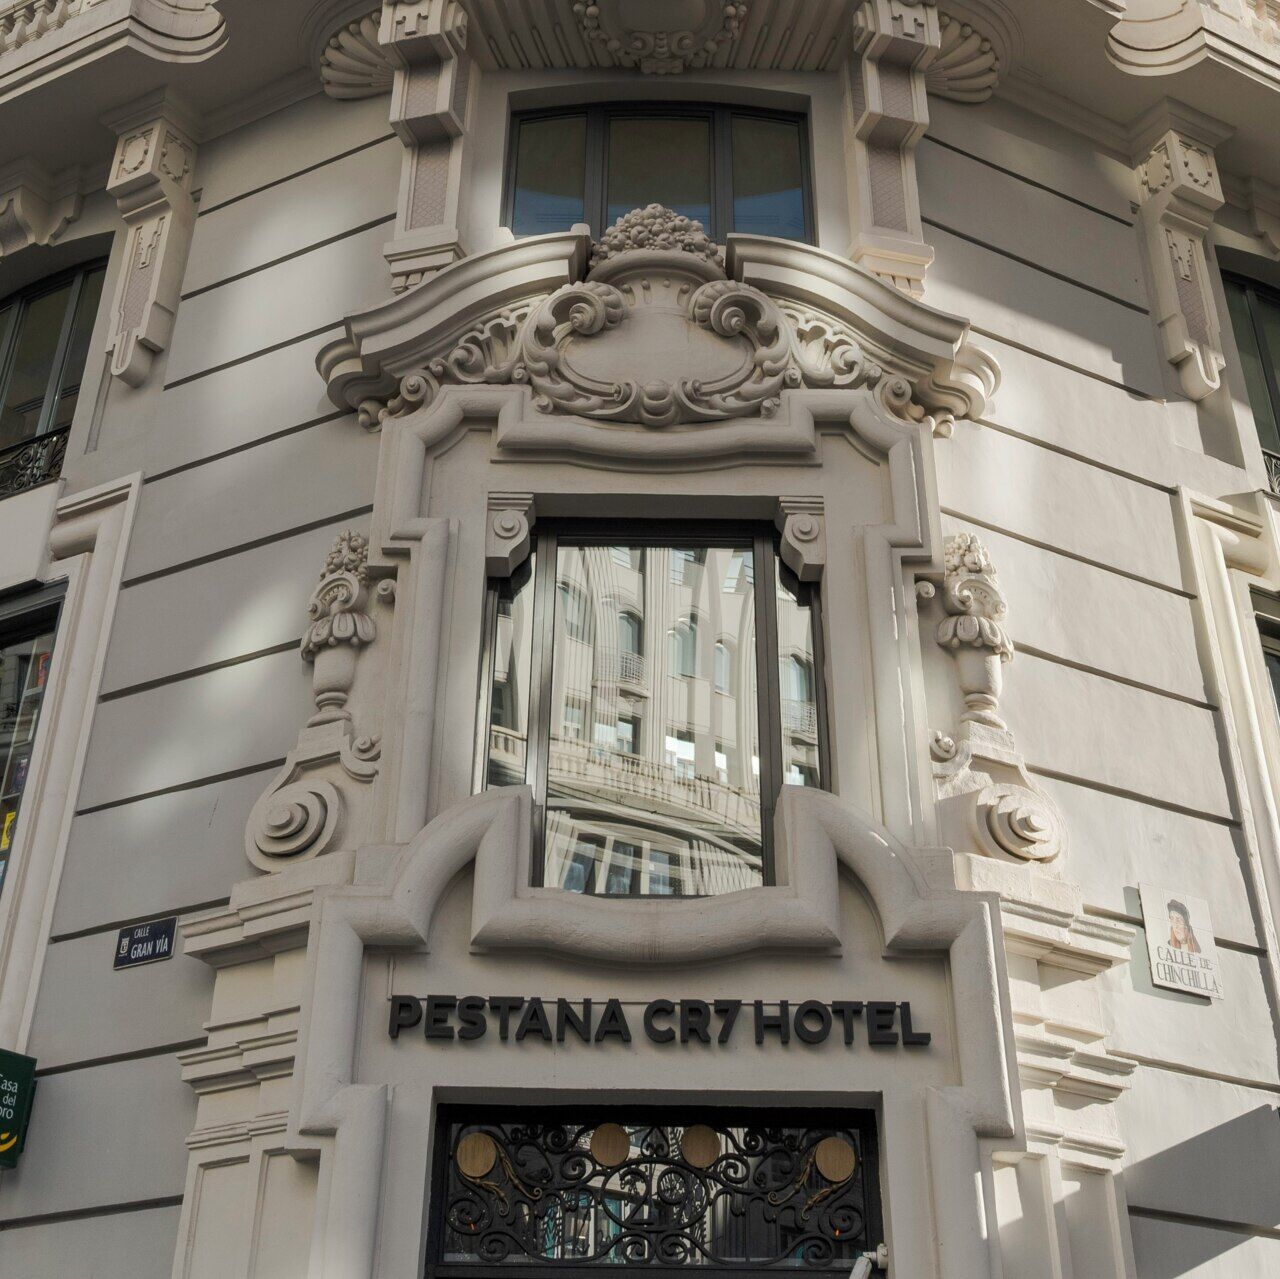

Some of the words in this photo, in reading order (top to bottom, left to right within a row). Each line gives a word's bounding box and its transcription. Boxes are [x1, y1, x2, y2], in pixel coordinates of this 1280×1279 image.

[133, 926, 150, 939] CALLE
[130, 941, 153, 959] GRAN
[155, 934, 168, 954] VÍA
[1157, 945, 1197, 969] CALLE
[1199, 956, 1213, 971] DE
[1156, 962, 1223, 994] CHINCHILLA
[389, 993, 632, 1044] PESTANA
[643, 998, 742, 1045] CR7
[754, 999, 931, 1047] HOTEL
[2, 1093, 17, 1107] del
